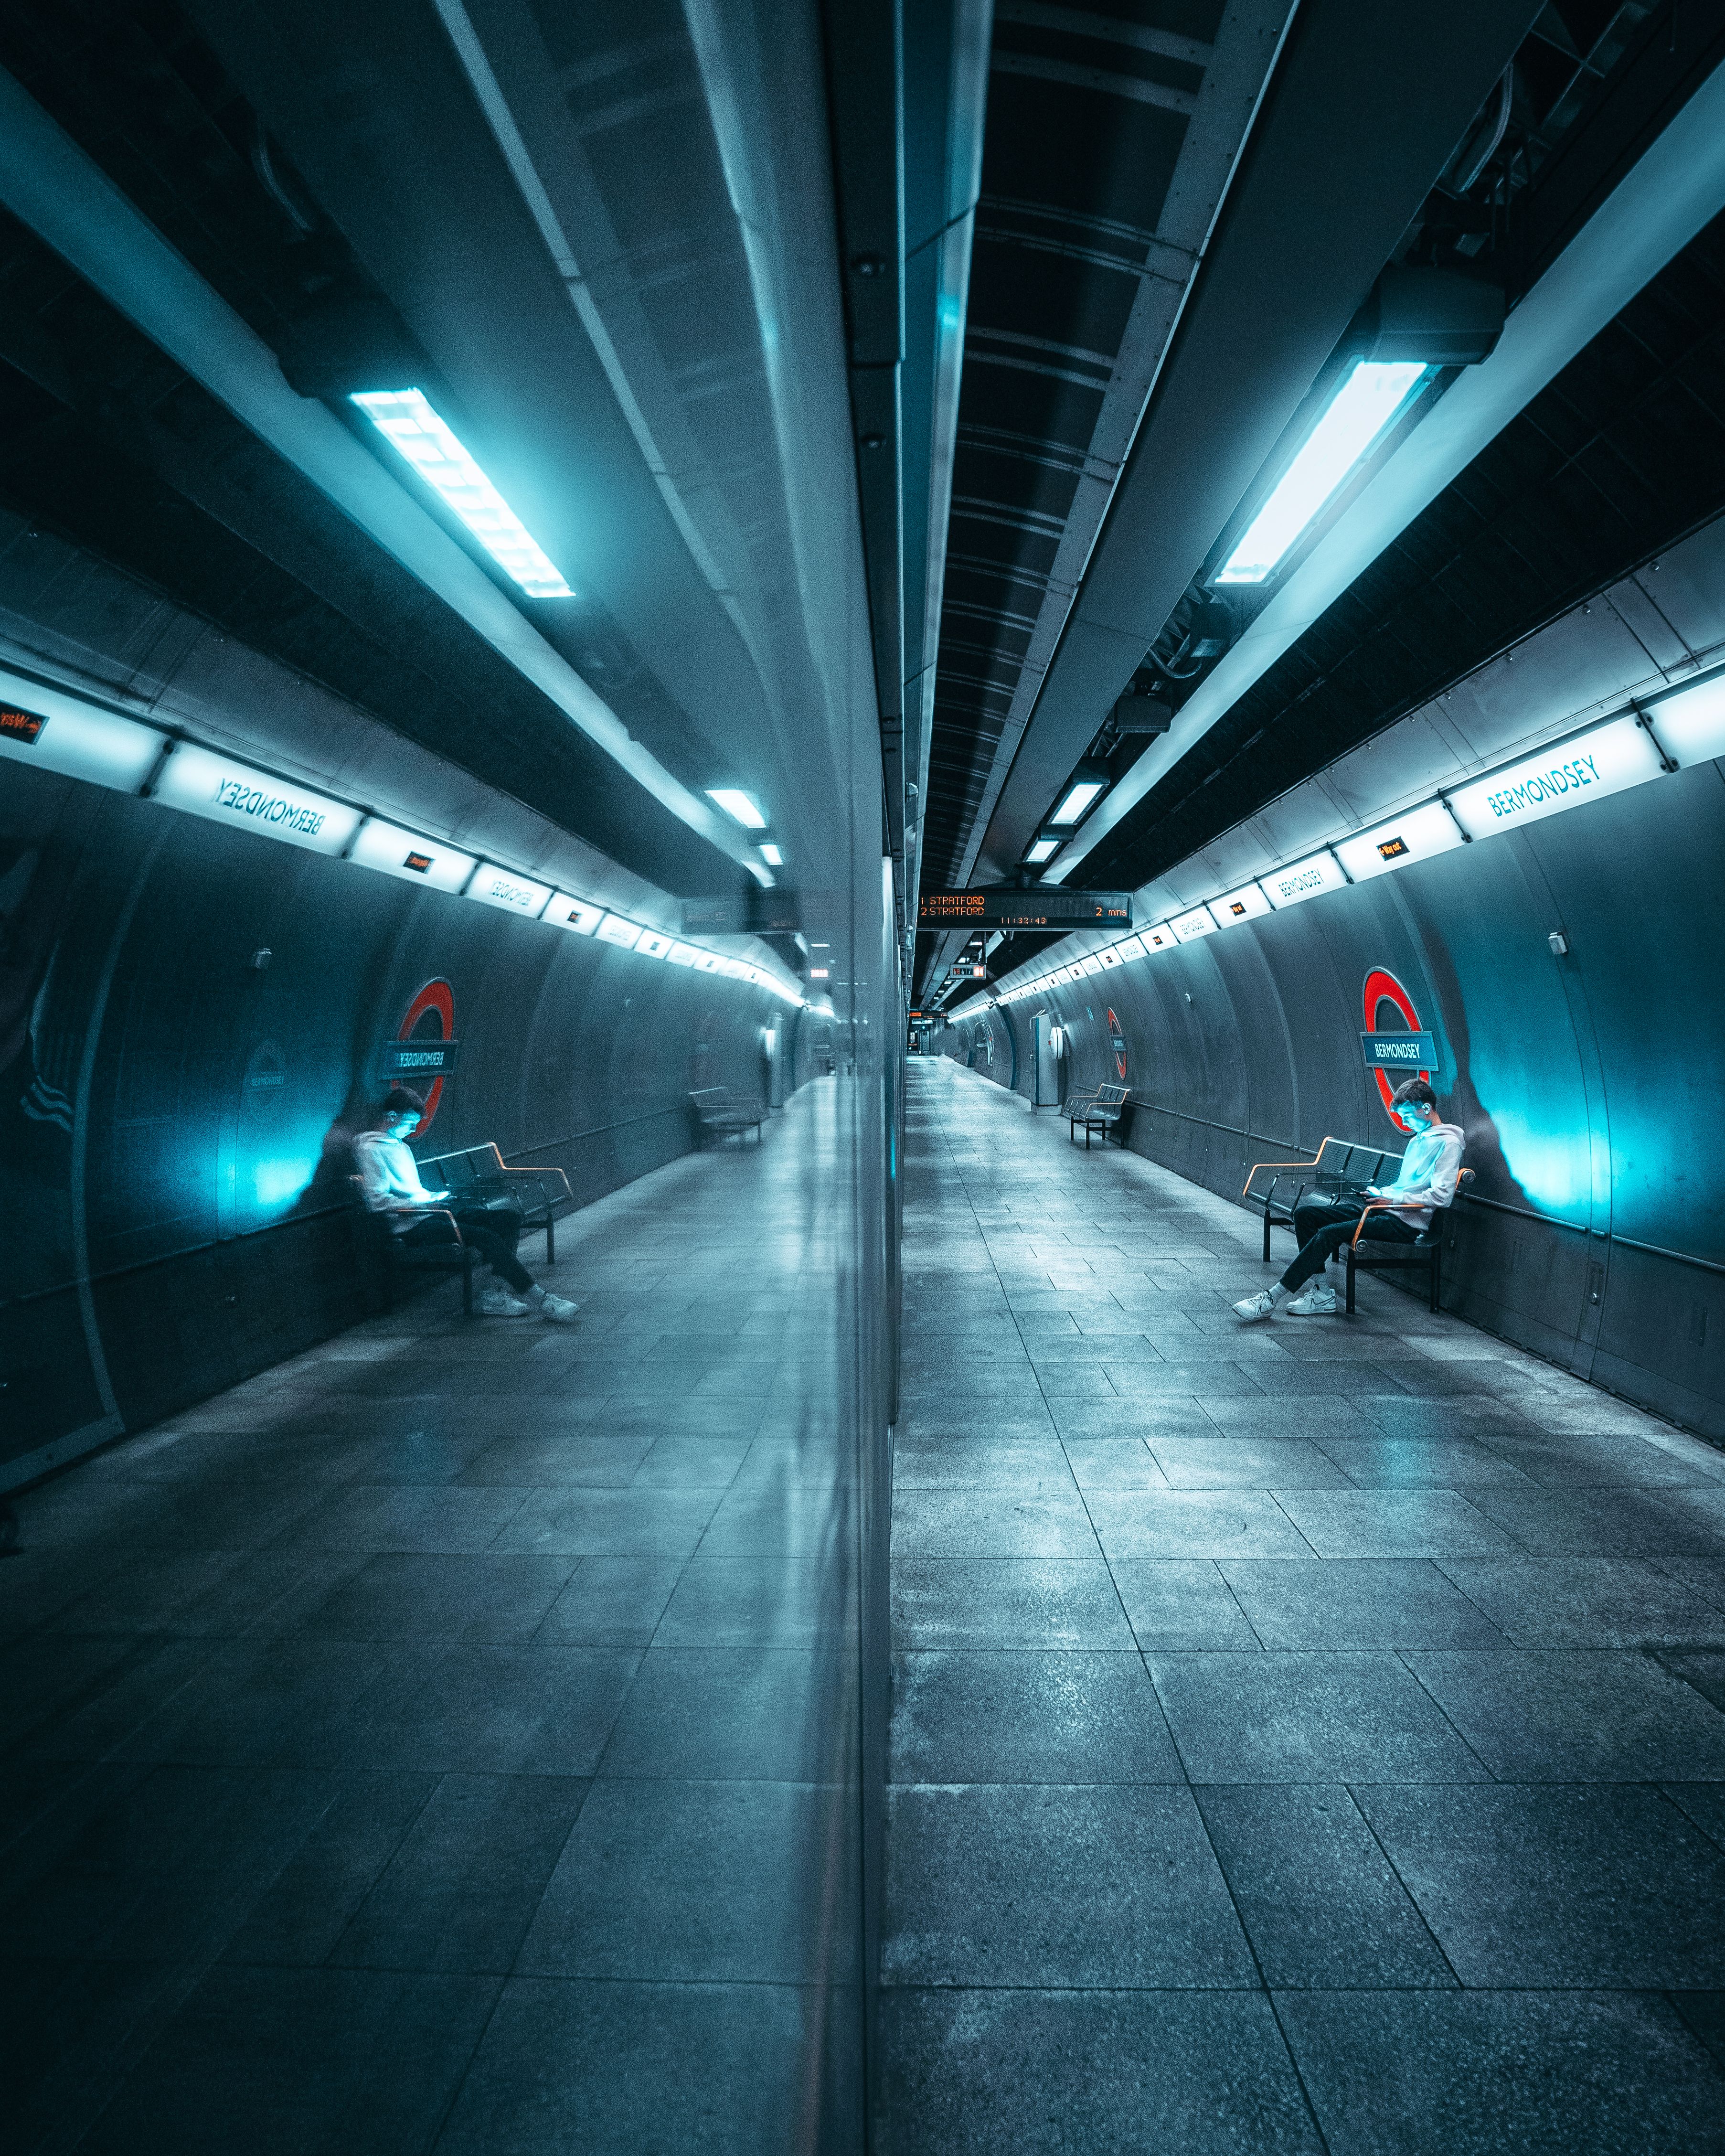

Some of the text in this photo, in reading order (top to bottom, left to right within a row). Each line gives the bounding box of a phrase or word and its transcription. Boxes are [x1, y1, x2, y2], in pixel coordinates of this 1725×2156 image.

[1487, 755, 1600, 817] BERMONDSEY
[1382, 842, 1402, 854] Way out
[1278, 868, 1324, 897] BERMONDSEY
[921, 896, 984, 905] 1 STRATFORD
[921, 907, 927, 916] 2
[930, 907, 984, 916] STRATFORD
[1096, 907, 1102, 916] 2
[1375, 1043, 1420, 1058] BERMONDSEY
